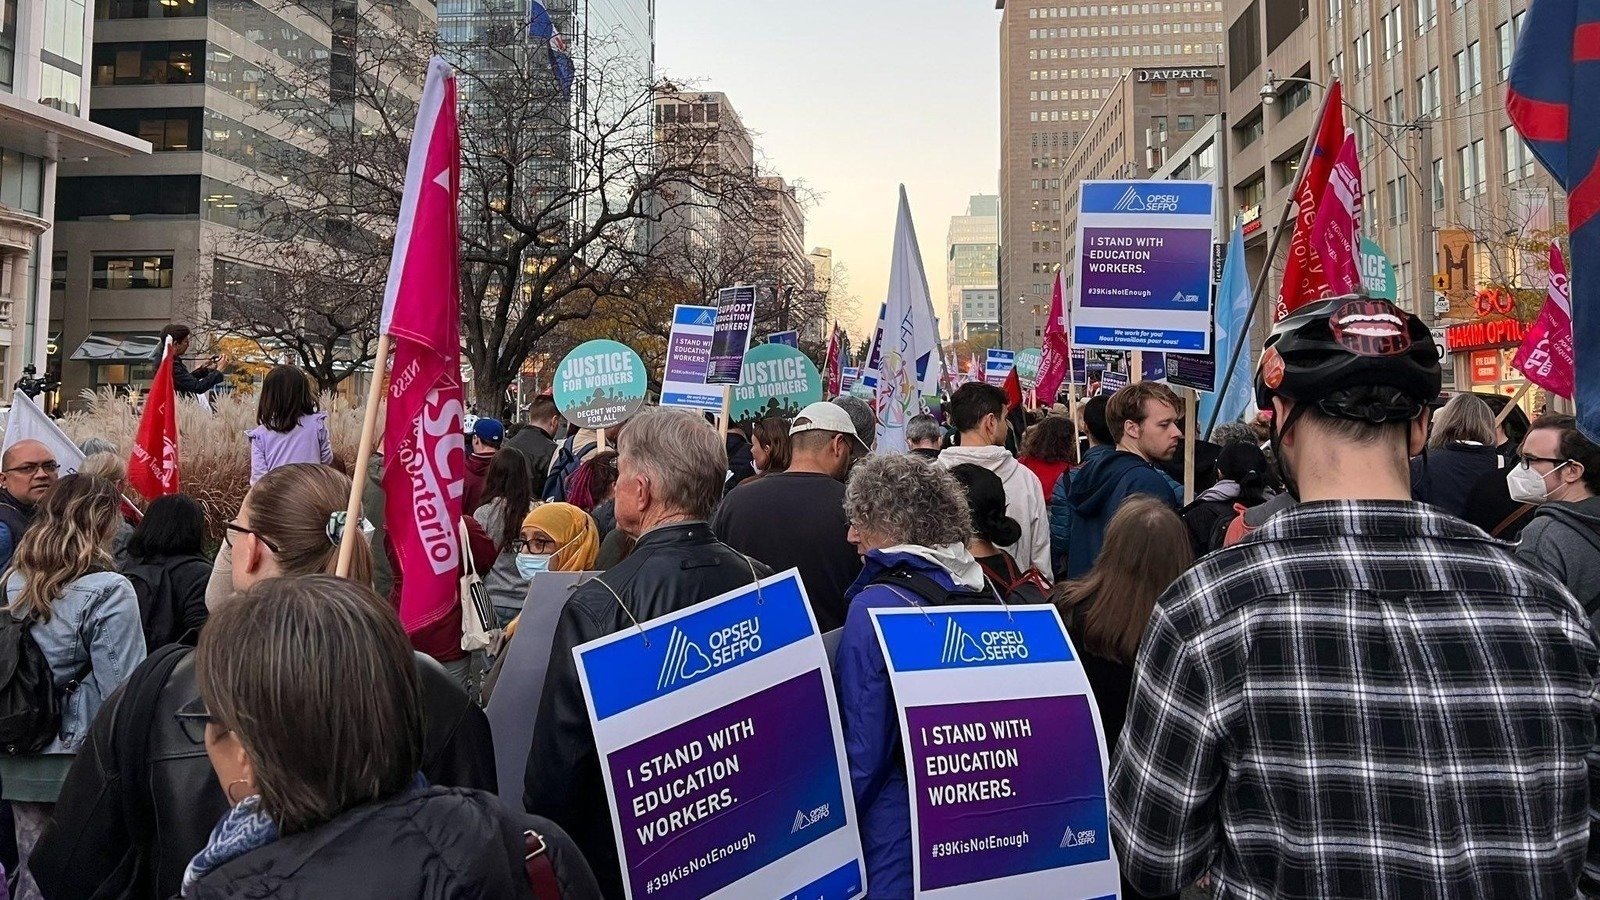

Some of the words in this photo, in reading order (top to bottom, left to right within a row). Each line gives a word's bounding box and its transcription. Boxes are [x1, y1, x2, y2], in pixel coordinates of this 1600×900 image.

[1138, 69, 1206, 82] DAVPART
[1147, 194, 1179, 203] OPSEU
[1146, 202, 1178, 212] SEFPO
[1090, 238, 1094, 247] I
[1097, 237, 1133, 247] STAND
[1136, 238, 1164, 247] WITH
[1090, 250, 1150, 260] EDUCATION
[1089, 263, 1146, 274] WORKERS.
[1088, 288, 1151, 297] #39KisNotEnough
[718, 304, 752, 314] SUPPORT
[717, 314, 750, 322] EDUCATION
[716, 323, 748, 332] WORKERS
[680, 338, 701, 346] STAND
[1447, 322, 1485, 348] HAKIM
[675, 347, 710, 355] EDUCATION
[562, 351, 633, 380] JUSTICE
[674, 354, 706, 363] WORKERS.
[563, 379, 581, 392] FOR
[585, 371, 633, 388] WORKERS
[735, 385, 755, 400] FOR
[758, 379, 809, 397] WORKERS
[577, 408, 604, 418] DECENT
[606, 405, 627, 413] WORK
[411, 447, 452, 563] Ontario
[709, 616, 760, 650] OPSEU
[981, 630, 1024, 646] OPSEU
[712, 634, 762, 668] SEFPO
[985, 644, 1028, 661] SEFPO
[921, 727, 927, 746] I
[933, 722, 986, 745] STAND
[990, 719, 1032, 740] WITH
[627, 769, 633, 788] I
[640, 741, 703, 783] STAND
[707, 717, 755, 752] WITH
[926, 748, 1019, 776] EDUCATION
[632, 754, 740, 818] EDUCATION
[928, 778, 1016, 806] WORKERS.
[636, 787, 738, 846] WORKERS.
[810, 803, 829, 817] OPSEU
[811, 810, 830, 823] SEFPO
[1077, 829, 1095, 838] OPSEU
[931, 831, 1029, 858] #39KisNotEnough
[1077, 837, 1095, 845] SEFPO
[646, 832, 756, 894] #39KisNotEnough
